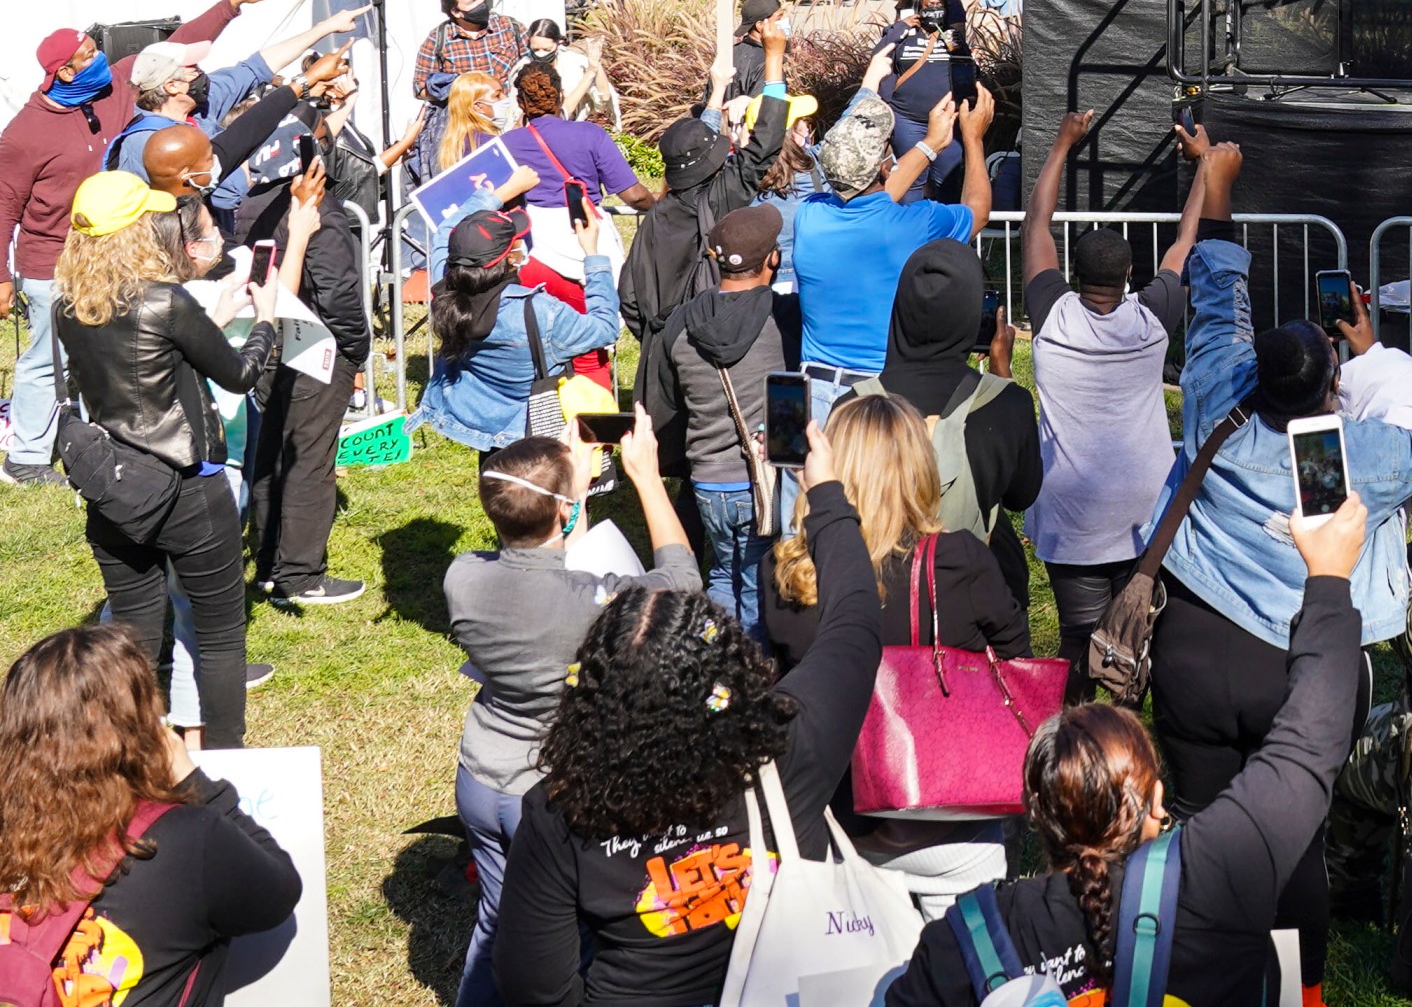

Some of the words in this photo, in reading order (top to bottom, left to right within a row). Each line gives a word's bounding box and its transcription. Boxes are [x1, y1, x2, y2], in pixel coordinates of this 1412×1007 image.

[340, 423, 393, 449] COUNT
[600, 835, 641, 858] They
[646, 843, 752, 898] LET'S
[825, 911, 874, 936] Nicky
